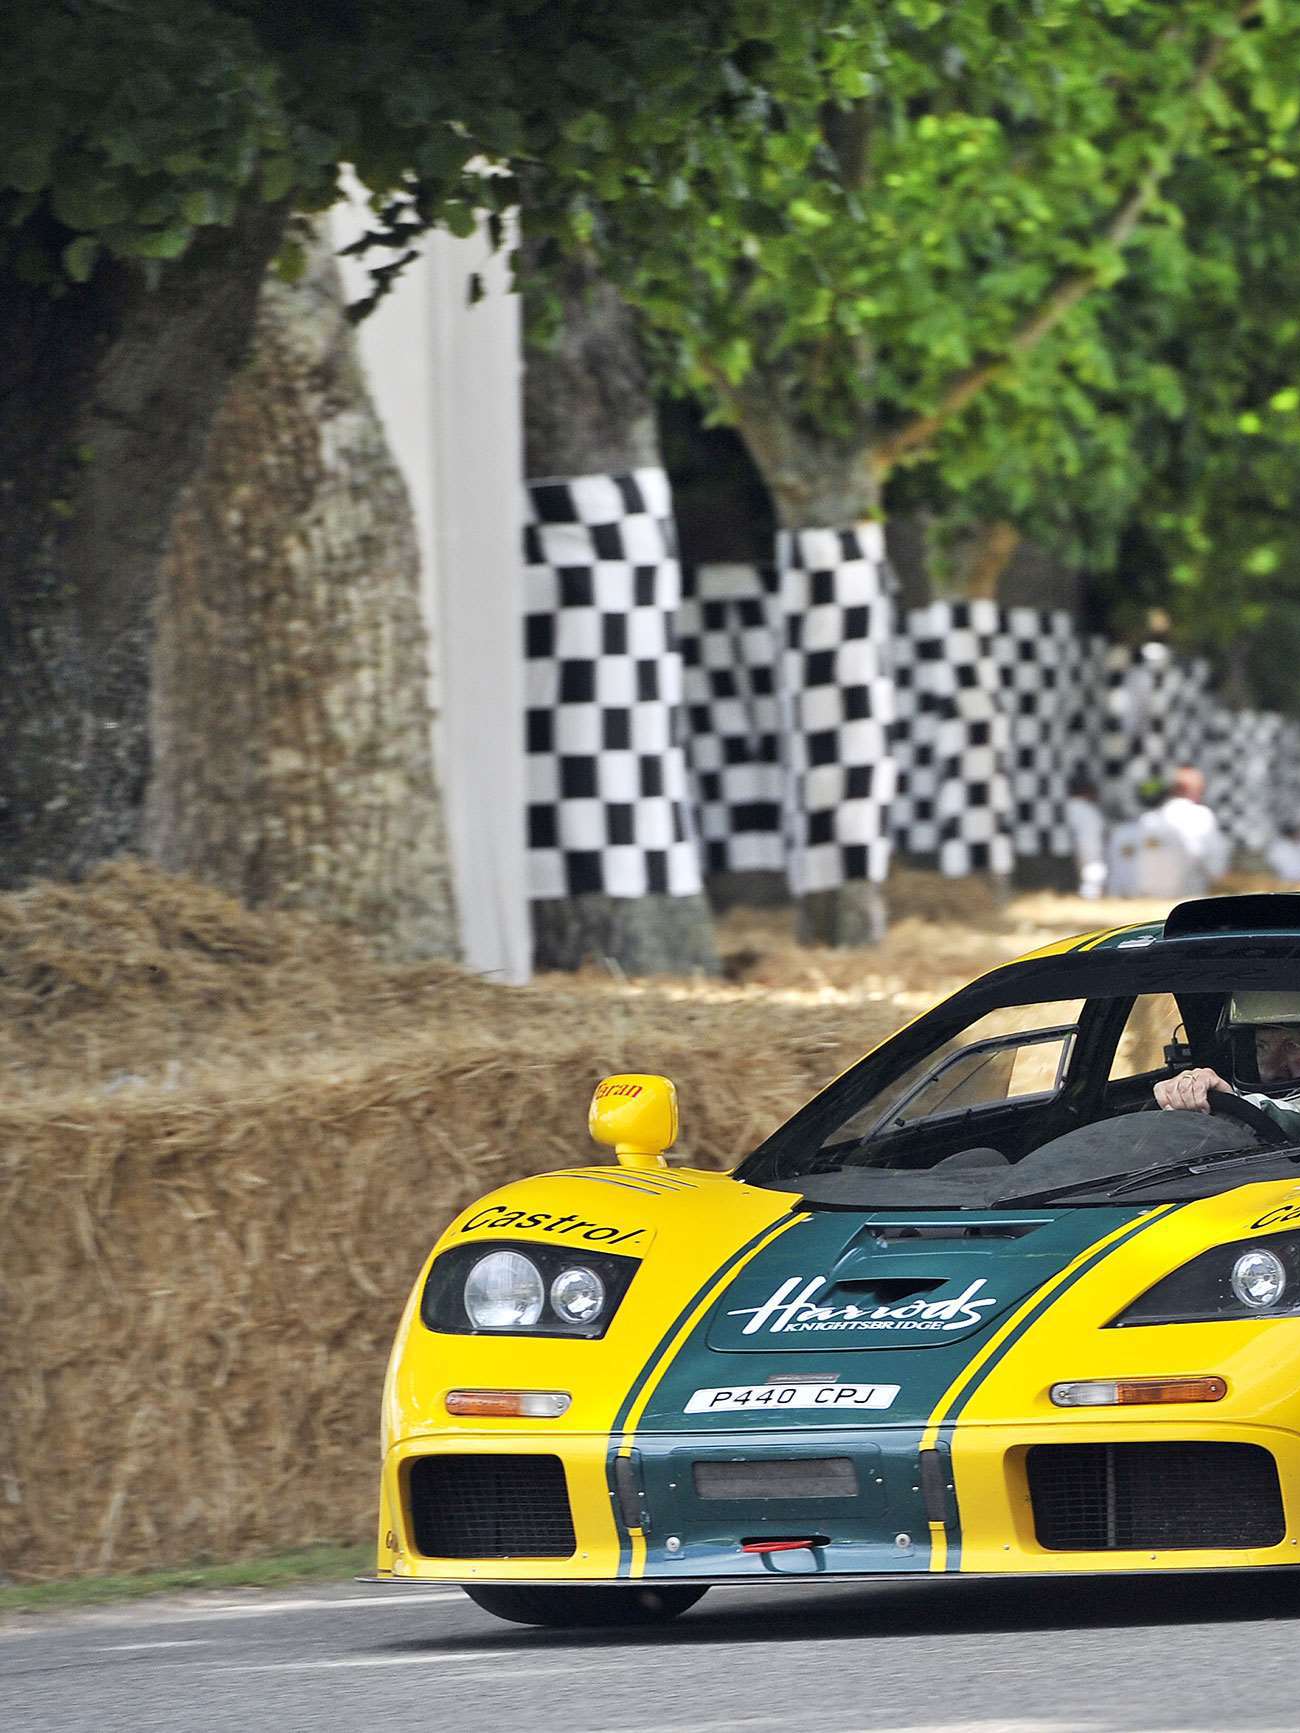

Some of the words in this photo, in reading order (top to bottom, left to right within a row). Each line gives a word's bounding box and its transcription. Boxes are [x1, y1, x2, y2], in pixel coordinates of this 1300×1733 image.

[461, 1205, 647, 1245] Castrol
[727, 1276, 997, 1335] Harrods
[782, 1320, 945, 1333] KNIGHTSBRIDGE
[709, 1389, 798, 1408] P440
[814, 1387, 876, 1405] CPJ
